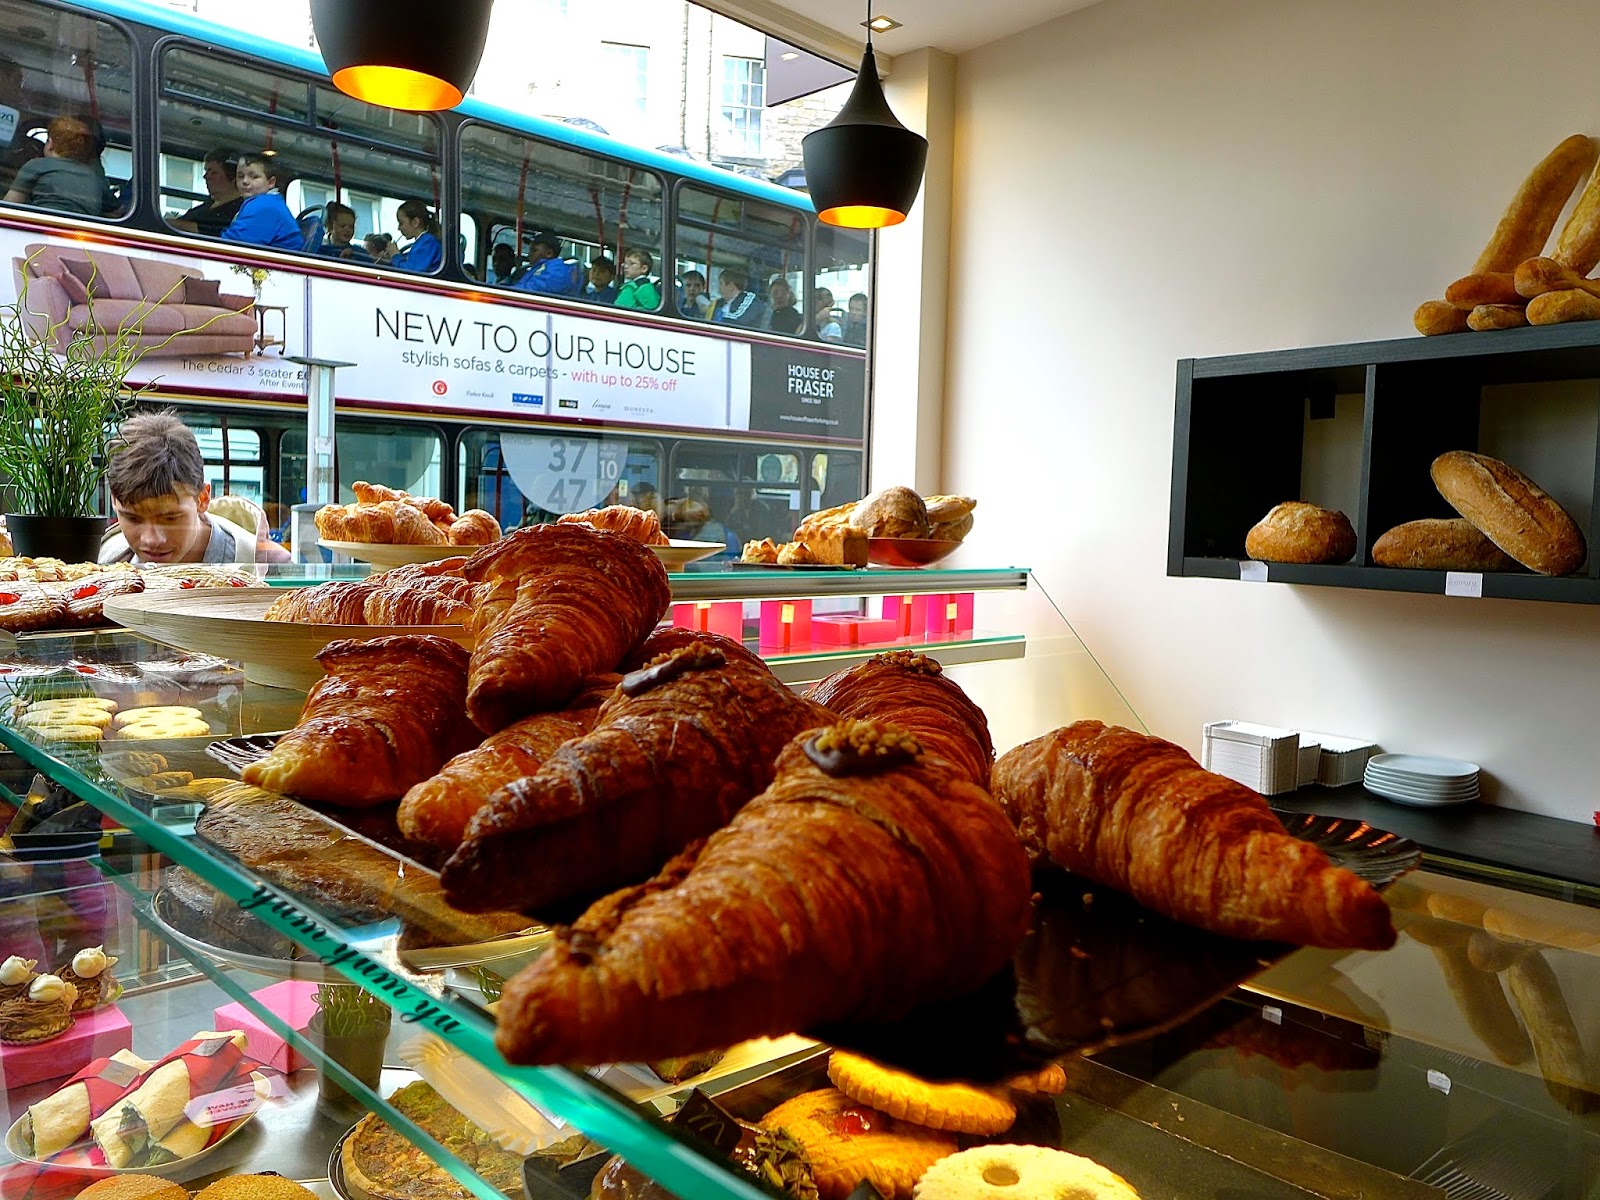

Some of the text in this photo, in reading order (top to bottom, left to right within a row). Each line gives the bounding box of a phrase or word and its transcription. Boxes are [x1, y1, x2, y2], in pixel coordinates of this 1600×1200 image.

[375, 307, 697, 376] NEW TO OUR HOUSE
[180, 359, 205, 372] The
[207, 361, 245, 376] Cedar
[247, 365, 256, 377] 3
[258, 367, 294, 380] seater
[402, 350, 450, 368] stylish
[453, 356, 492, 373] sofas
[494, 359, 506, 374] &
[508, 363, 559, 380] carpets
[570, 369, 599, 384] with
[601, 374, 617, 388] up
[620, 375, 633, 388] to
[635, 375, 660, 391] 25%
[661, 379, 678, 392] off
[787, 364, 836, 382] HOUSE OF
[259, 378, 304, 390] After Event
[788, 377, 834, 398] FRASER
[548, 439, 588, 473] 37
[599, 460, 618, 480] 10
[547, 478, 587, 511] 47
